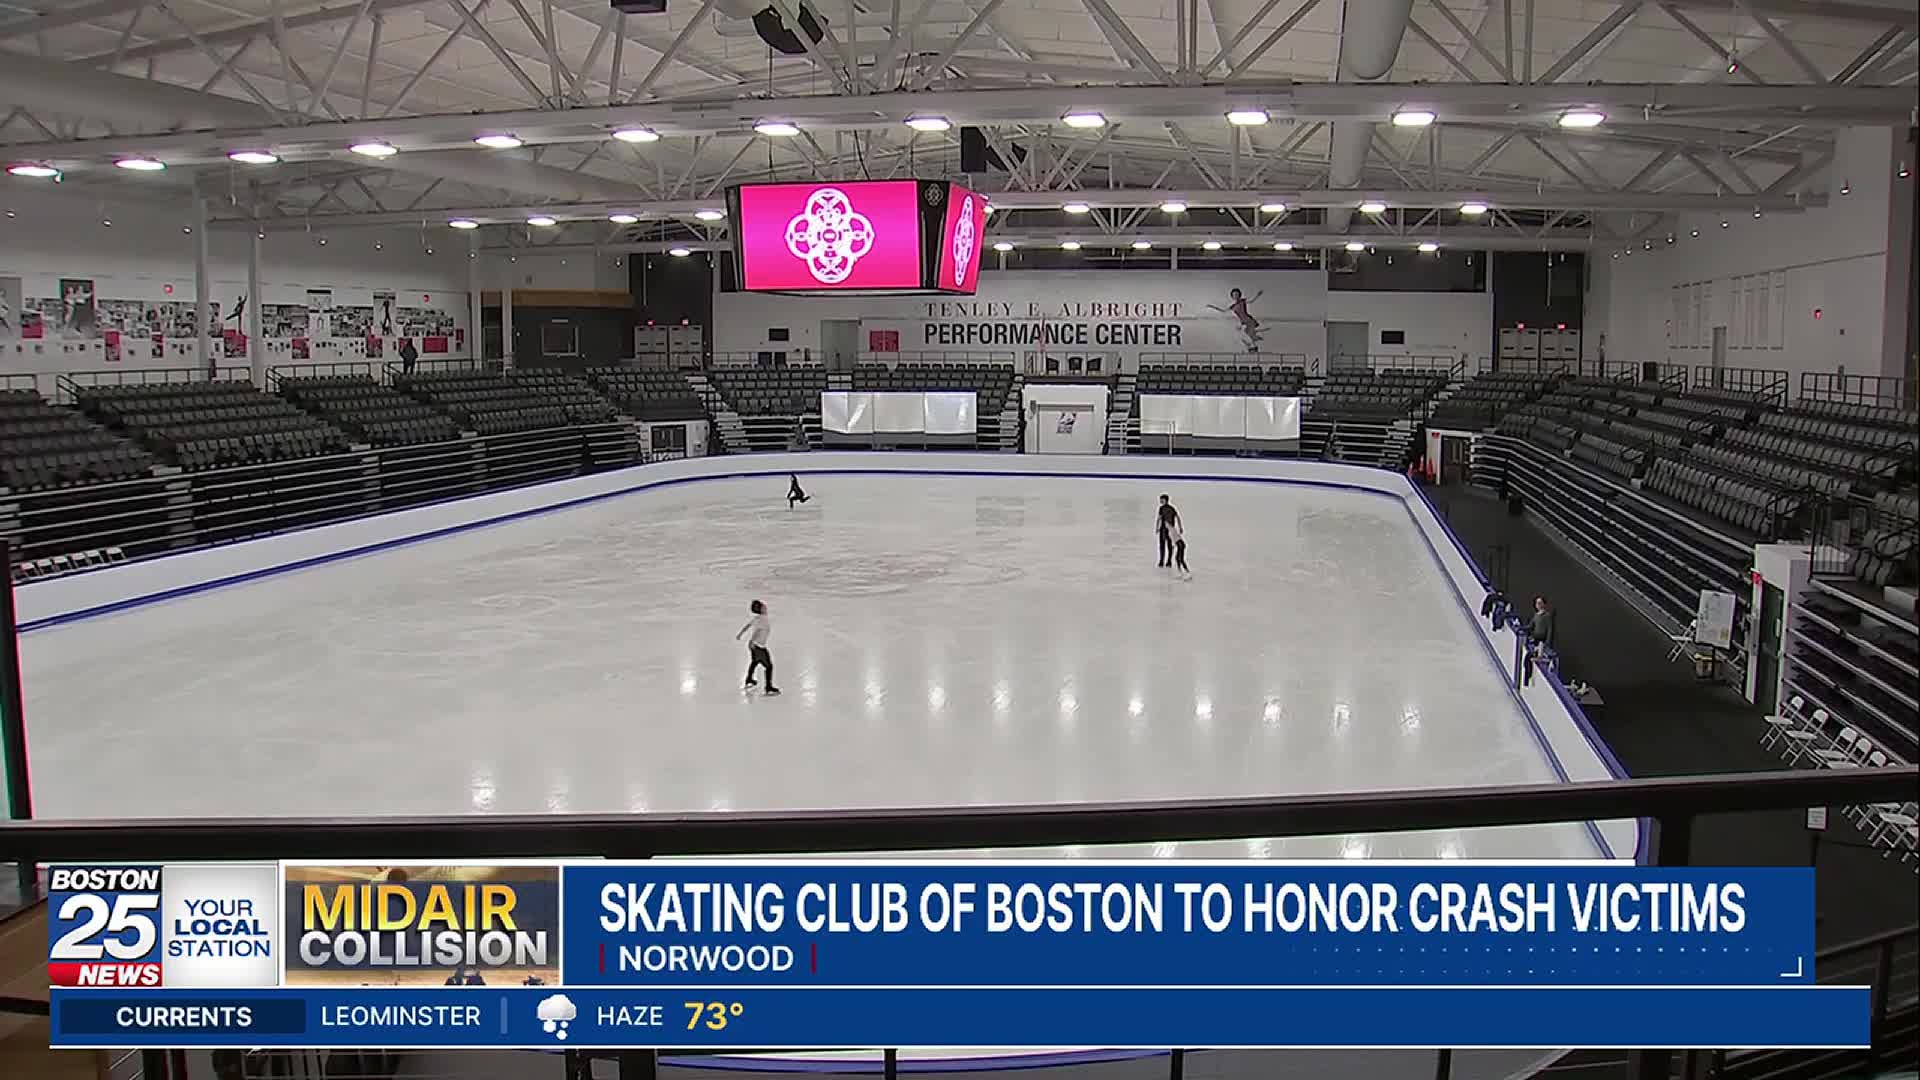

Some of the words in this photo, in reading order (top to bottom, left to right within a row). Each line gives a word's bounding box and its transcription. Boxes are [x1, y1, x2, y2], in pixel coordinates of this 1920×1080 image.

[924, 302, 1012, 317] TENLEY
[1061, 302, 1184, 317] ALBRIGHT
[924, 323, 1088, 345] PERFORMANCE
[1096, 323, 1182, 345] CENTER
